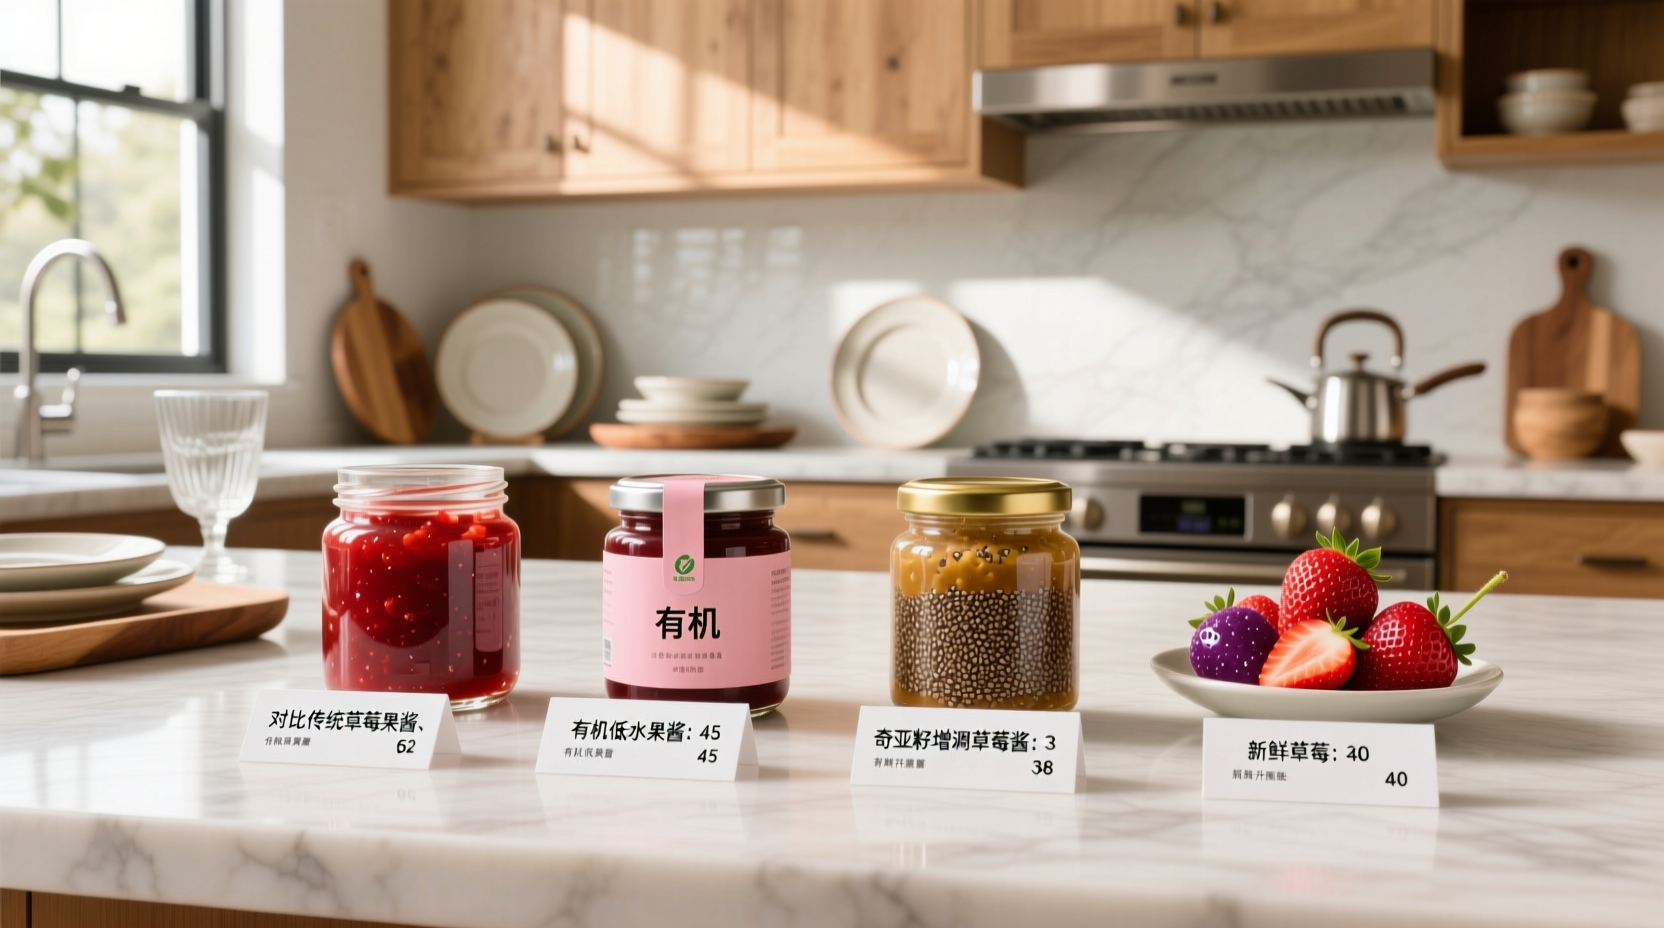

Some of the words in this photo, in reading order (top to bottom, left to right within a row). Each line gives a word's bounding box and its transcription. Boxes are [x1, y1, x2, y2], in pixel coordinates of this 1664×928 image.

[655, 605, 721, 640] 有机
[698, 724, 721, 741] 45
[396, 739, 417, 755] 62
[696, 748, 719, 764] 45
[1031, 759, 1054, 776] 38
[1384, 770, 1409, 788] 40
